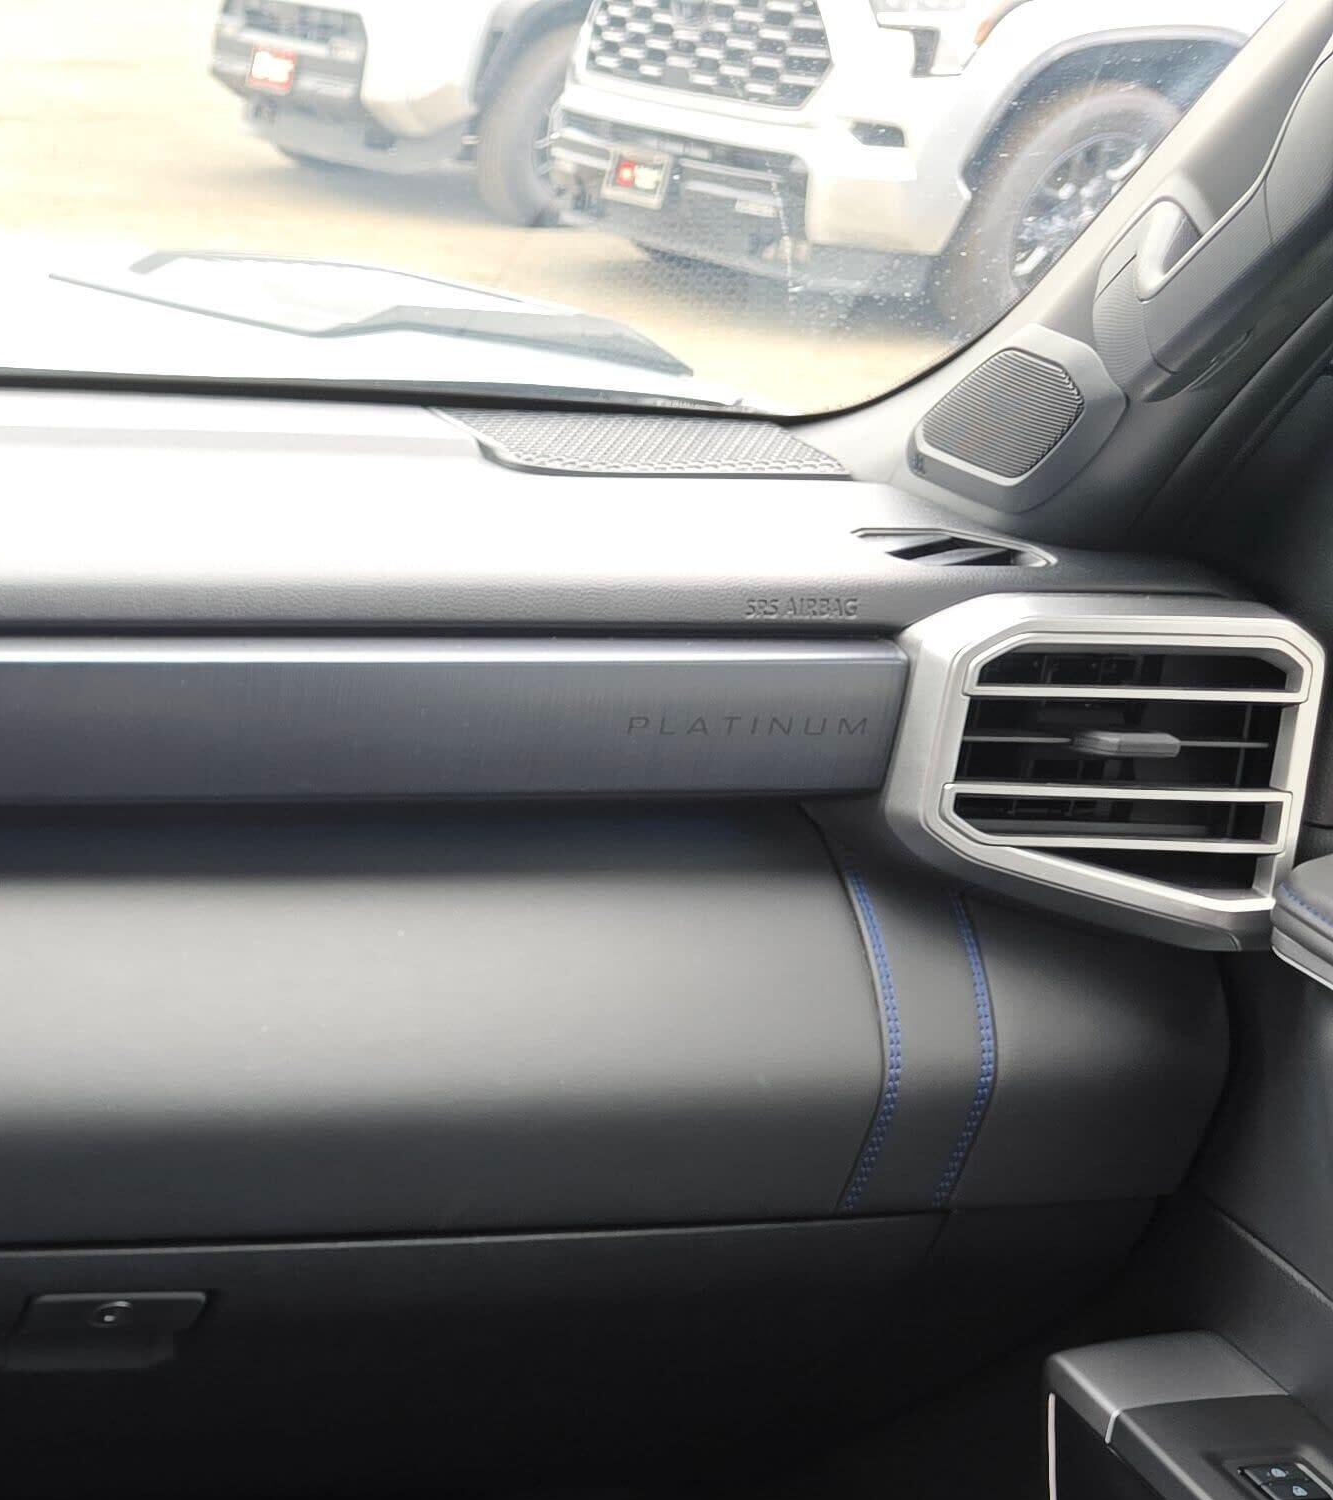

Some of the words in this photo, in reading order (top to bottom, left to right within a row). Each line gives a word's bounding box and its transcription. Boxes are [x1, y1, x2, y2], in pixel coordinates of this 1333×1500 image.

[745, 598, 780, 619] SRS
[785, 597, 859, 620] AIRBAG
[627, 715, 869, 736] PLATINUM
